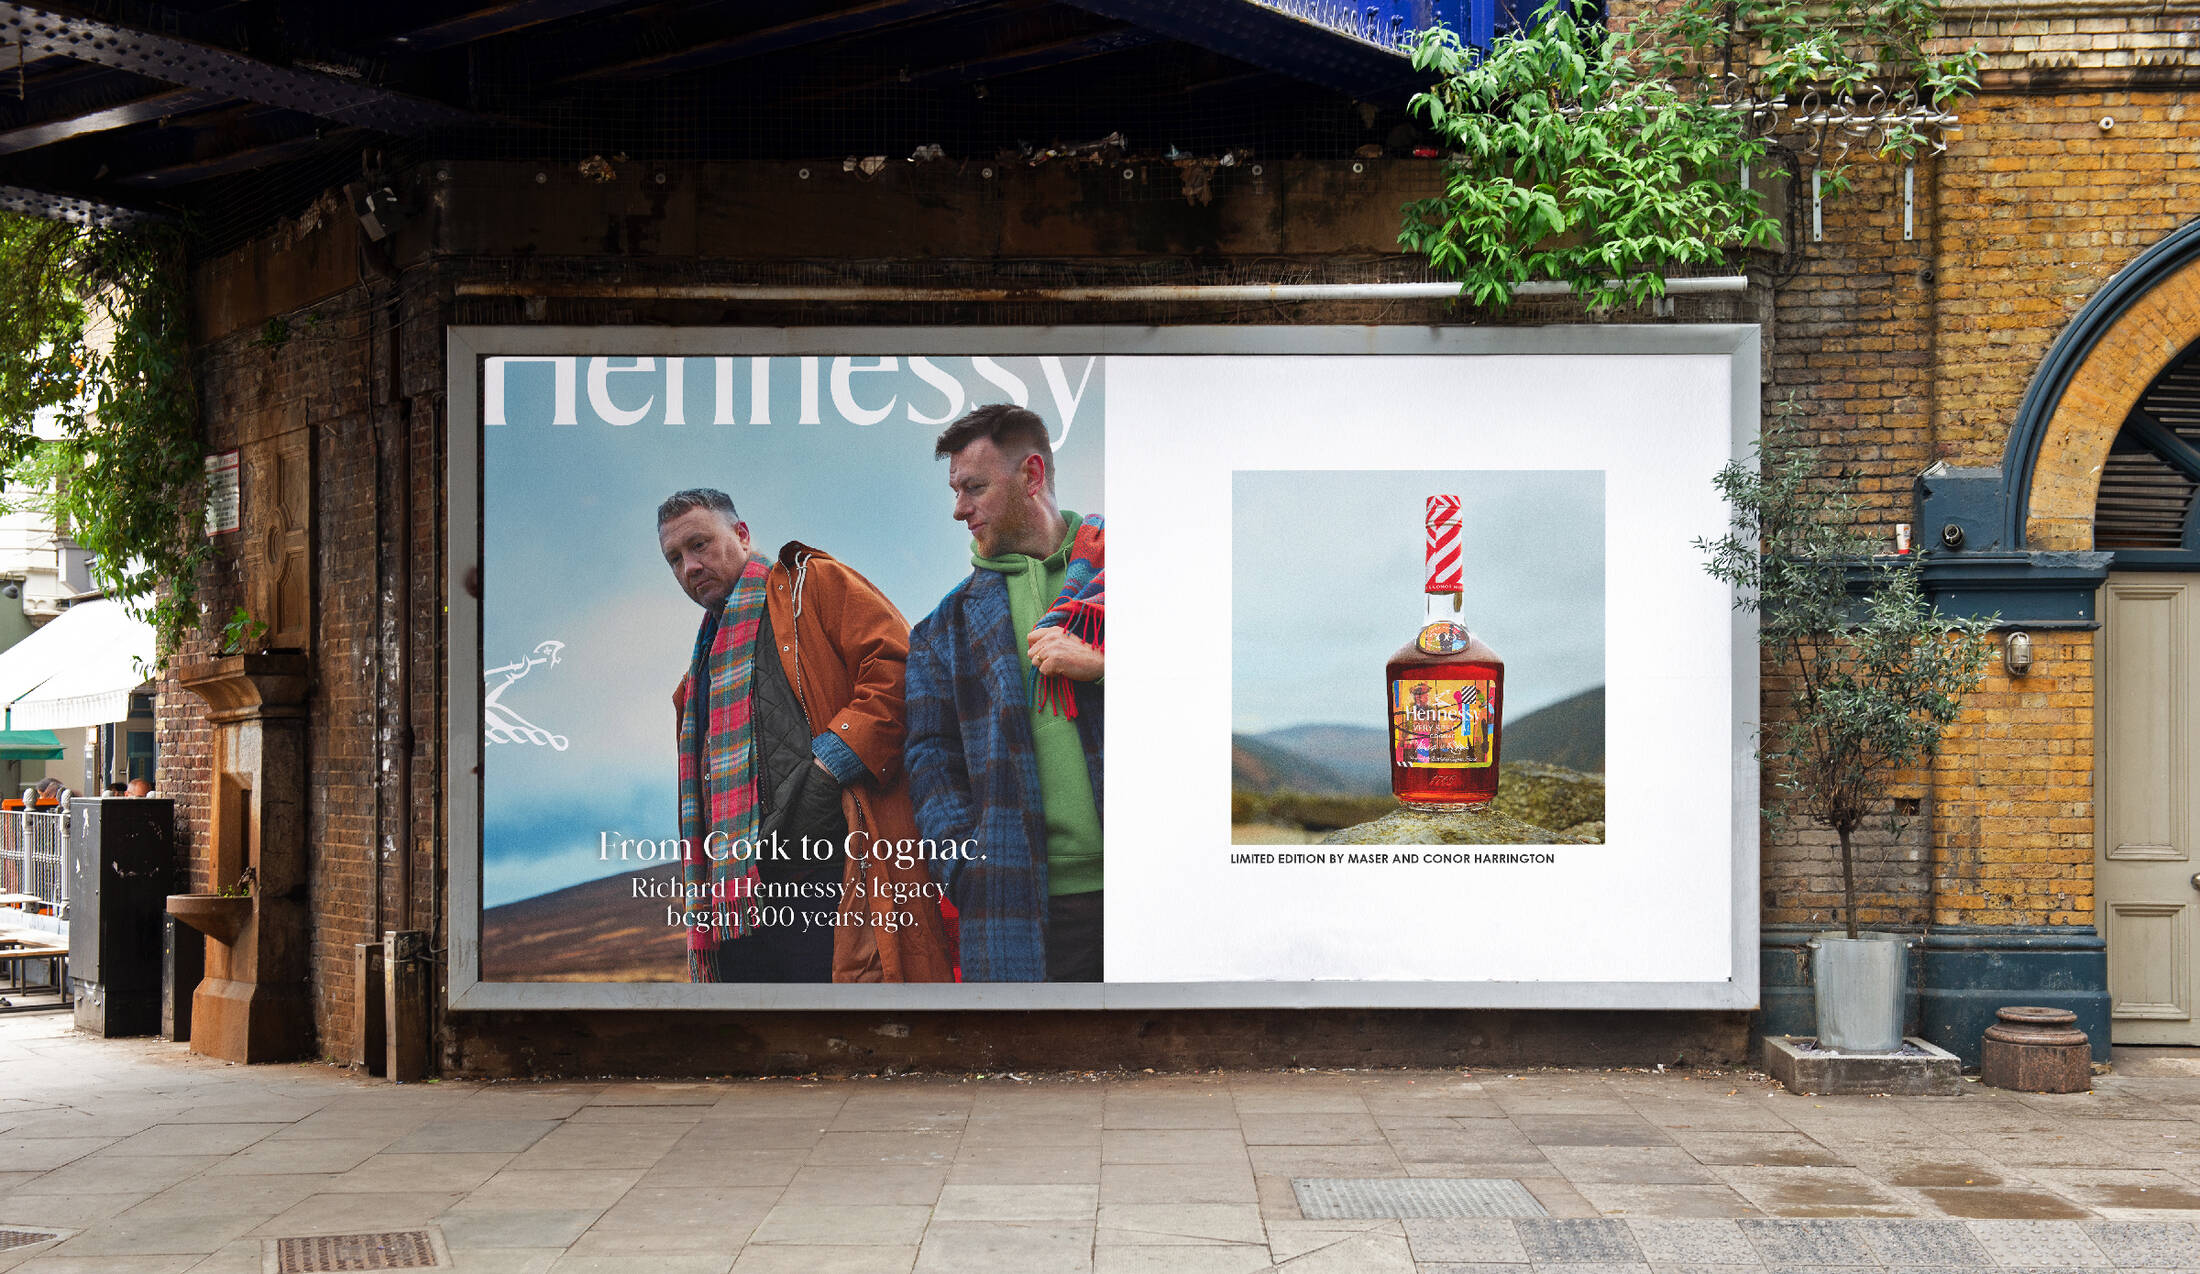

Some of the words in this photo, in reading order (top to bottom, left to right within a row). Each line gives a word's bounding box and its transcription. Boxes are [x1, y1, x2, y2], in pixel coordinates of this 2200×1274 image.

[1406, 705, 1479, 726] Hennessy
[599, 830, 693, 861] From
[703, 830, 792, 861] Cork
[801, 834, 834, 861] to
[843, 830, 987, 870] Cognac.
[1231, 853, 1275, 864] LIMITED
[1278, 853, 1326, 864] EDITION
[1329, 853, 1345, 864] BY
[1348, 853, 1389, 864] MASER
[1392, 853, 1419, 864] AND
[1423, 853, 1471, 864] CONOR
[1474, 853, 1555, 864] HARRINGTON
[631, 876, 726, 898] Richard
[873, 876, 949, 904] legacy
[667, 905, 740, 933] began
[746, 905, 795, 928] 300
[802, 910, 863, 933] years
[871, 911, 919, 933] ago.
